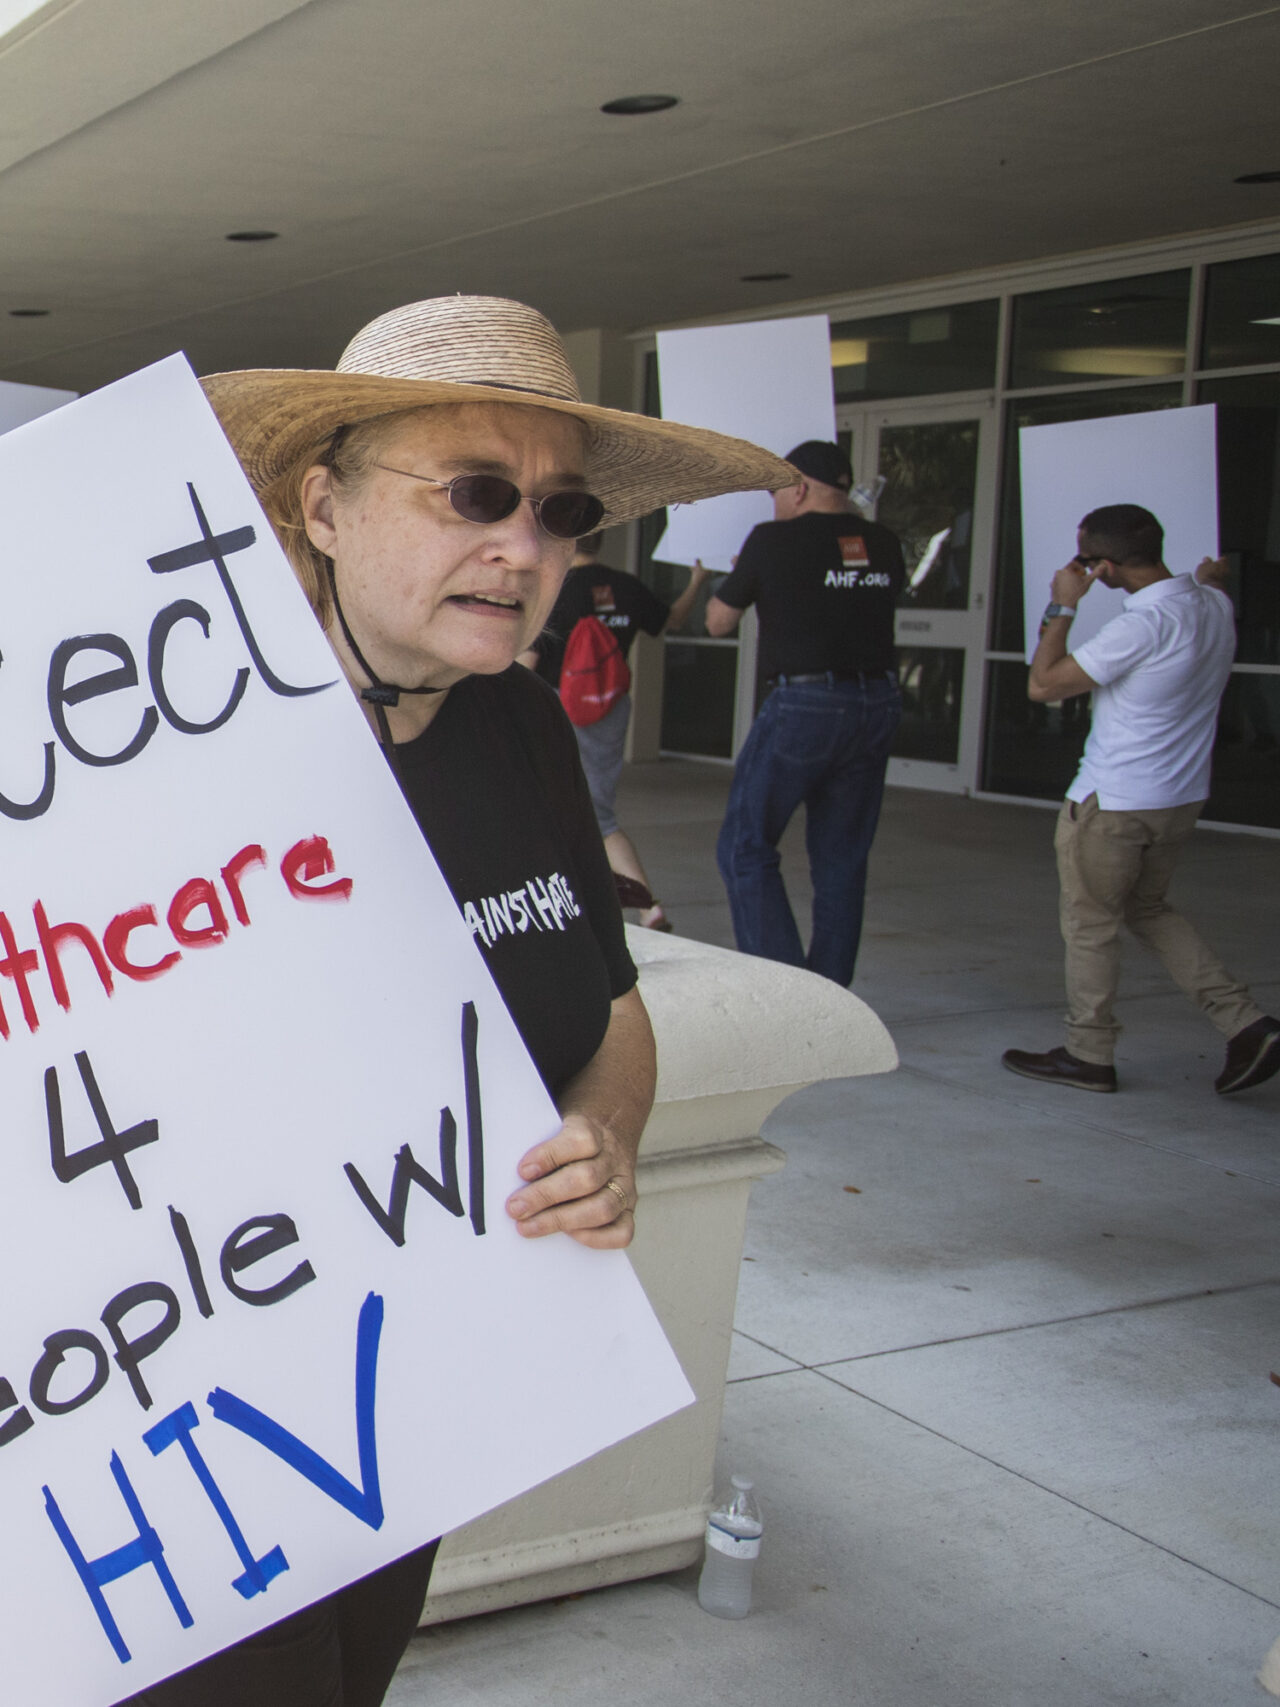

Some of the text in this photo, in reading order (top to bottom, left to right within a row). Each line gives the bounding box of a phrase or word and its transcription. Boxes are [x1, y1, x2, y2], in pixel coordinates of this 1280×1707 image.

[44, 1051, 160, 1211] 4
[343, 1000, 488, 1248] W/
[41, 1290, 386, 1665] HIV
